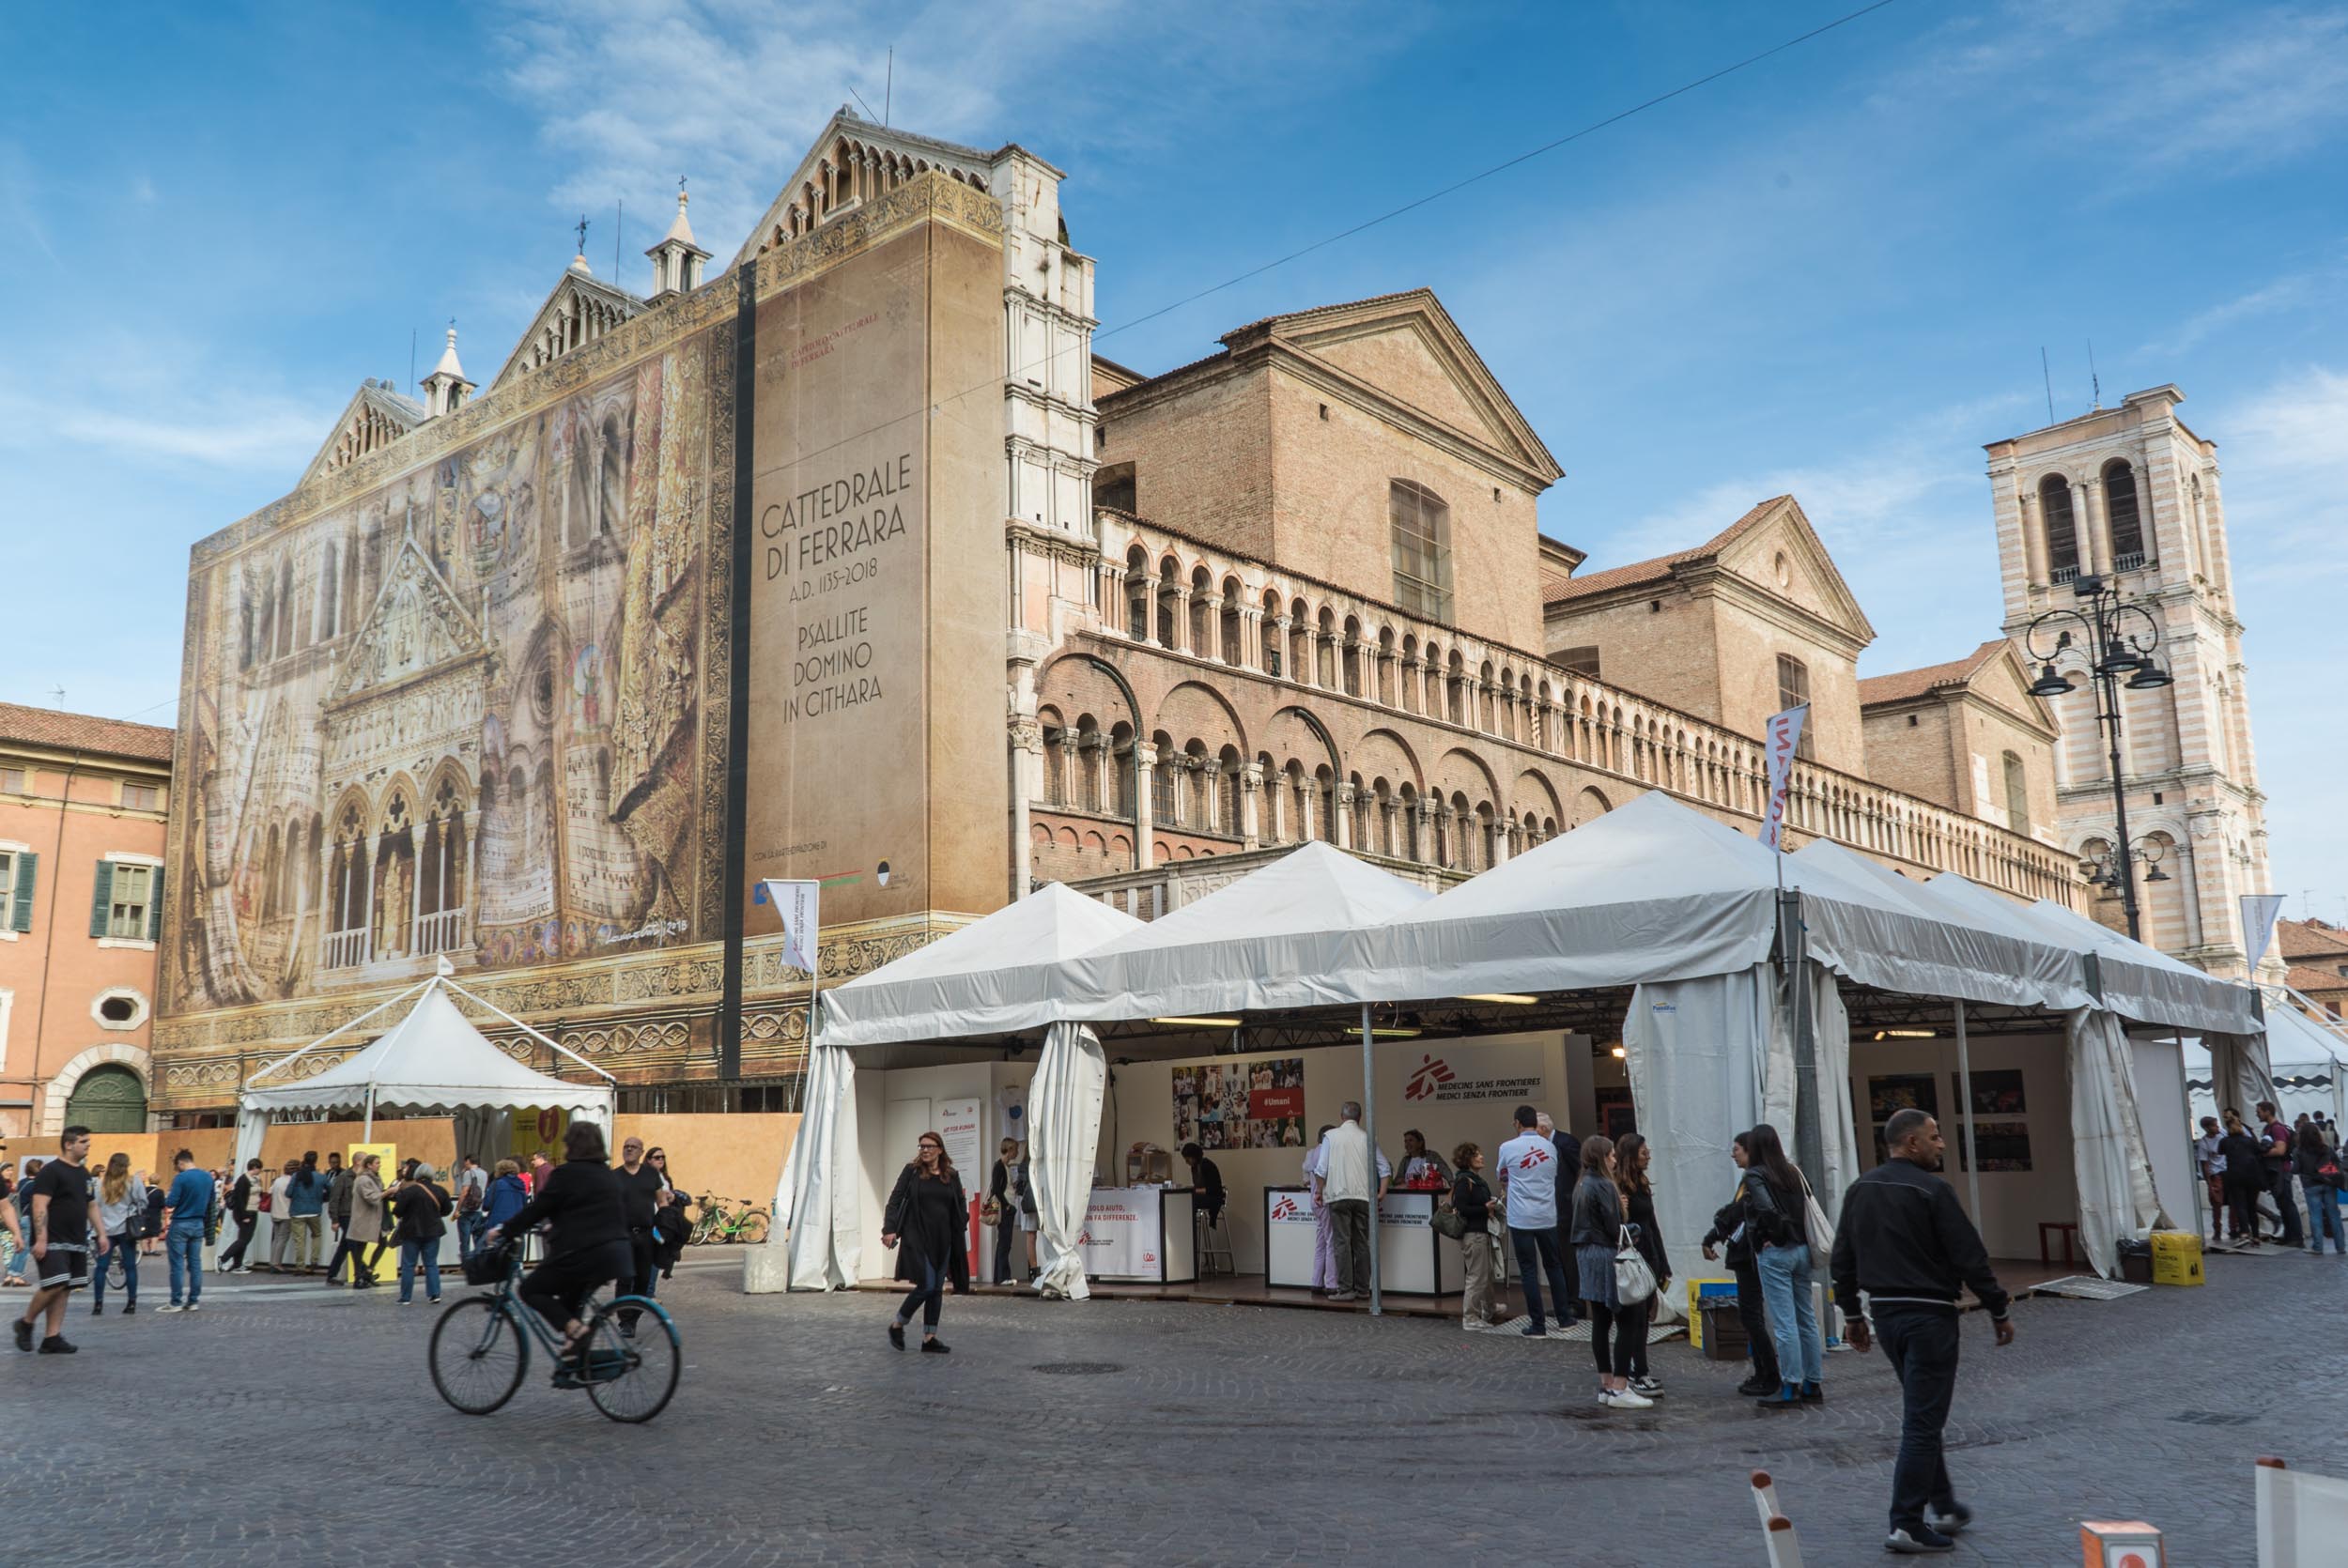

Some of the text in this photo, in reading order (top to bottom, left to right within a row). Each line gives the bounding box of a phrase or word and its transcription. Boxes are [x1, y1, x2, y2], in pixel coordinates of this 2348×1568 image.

[761, 453, 911, 539] CATTEDRALE
[767, 502, 906, 580] DI FERRARA
[789, 581, 815, 604] A.D.
[798, 607, 868, 652] PSALLITE
[795, 641, 873, 687] DOMINO
[783, 675, 883, 724] IN CITHARA
[1436, 1089, 1529, 1100] MEDICI SENZA FRONTIERE
[1438, 1077, 1540, 1090] MEDECINS SANS FRONTIERES
[1264, 1097, 1290, 1107] #Umani
[435, 1166, 450, 1182] del
